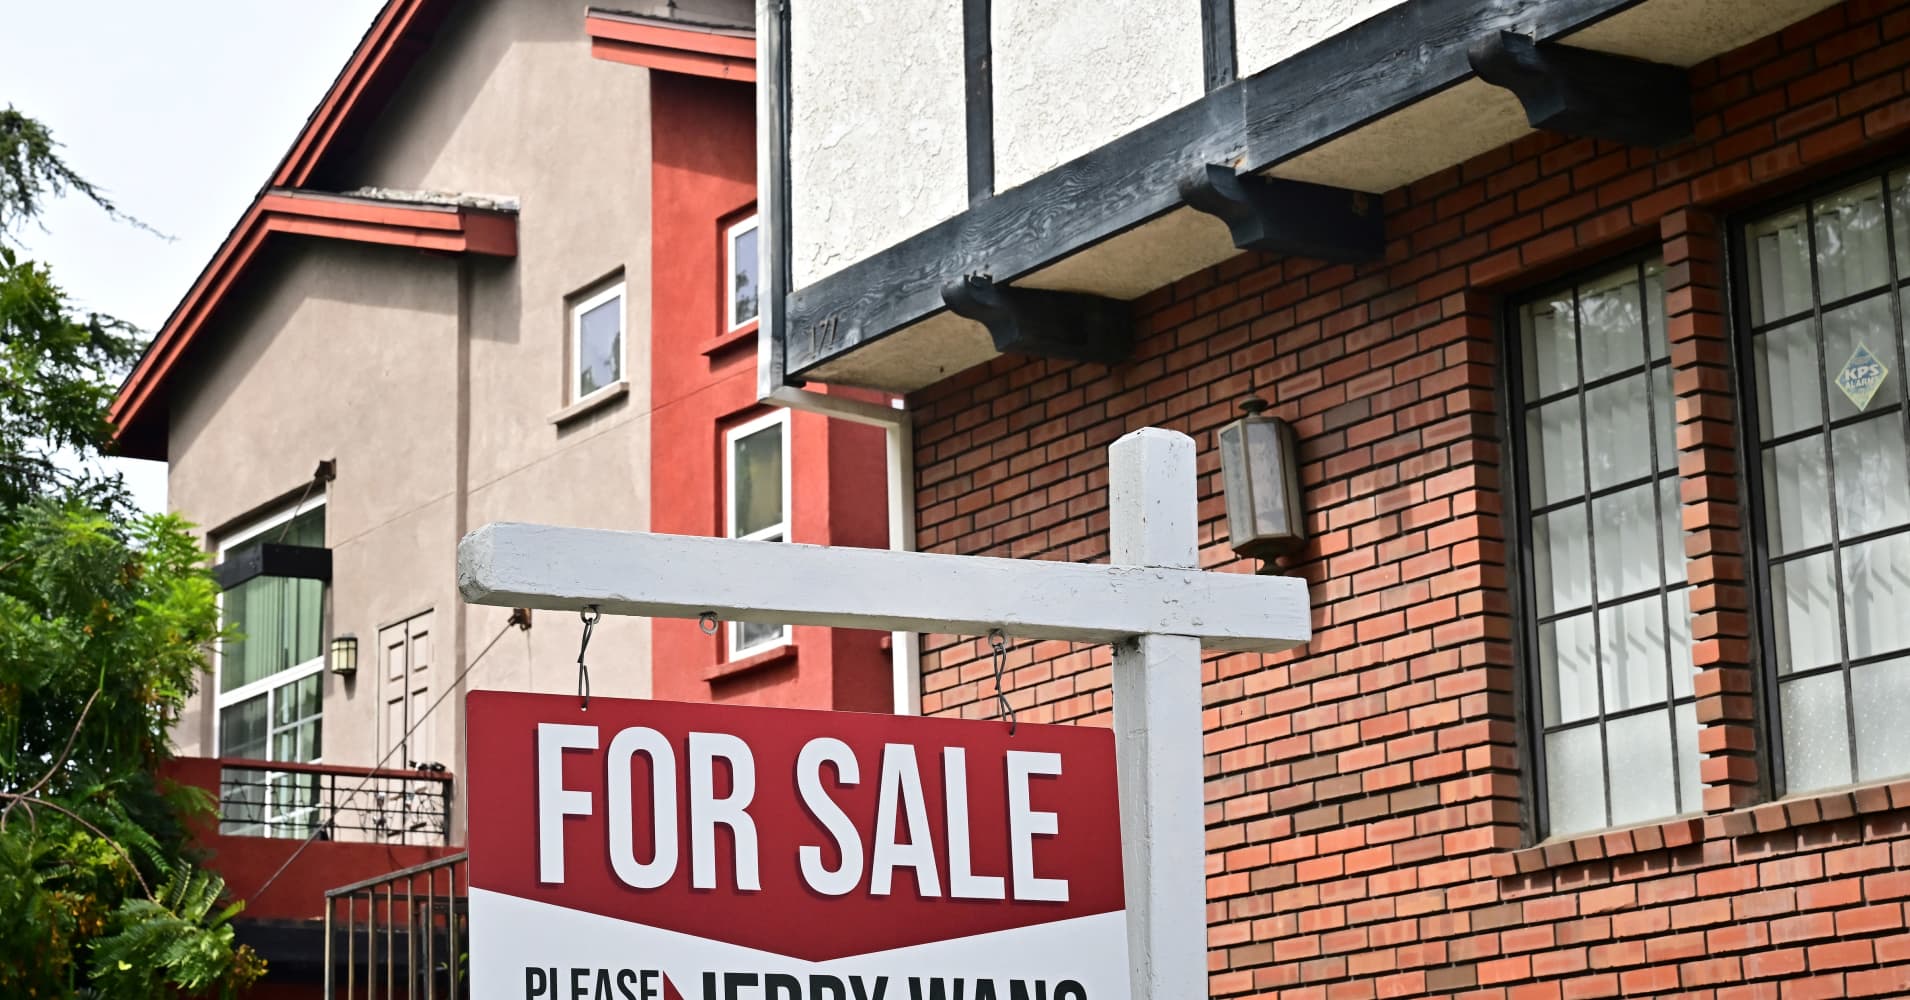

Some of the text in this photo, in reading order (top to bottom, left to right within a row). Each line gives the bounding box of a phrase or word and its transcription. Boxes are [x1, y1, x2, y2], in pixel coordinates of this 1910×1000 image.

[1845, 364, 1879, 380] KPS
[538, 723, 1069, 901] FOR SALE
[526, 967, 659, 1000] PLEASE
